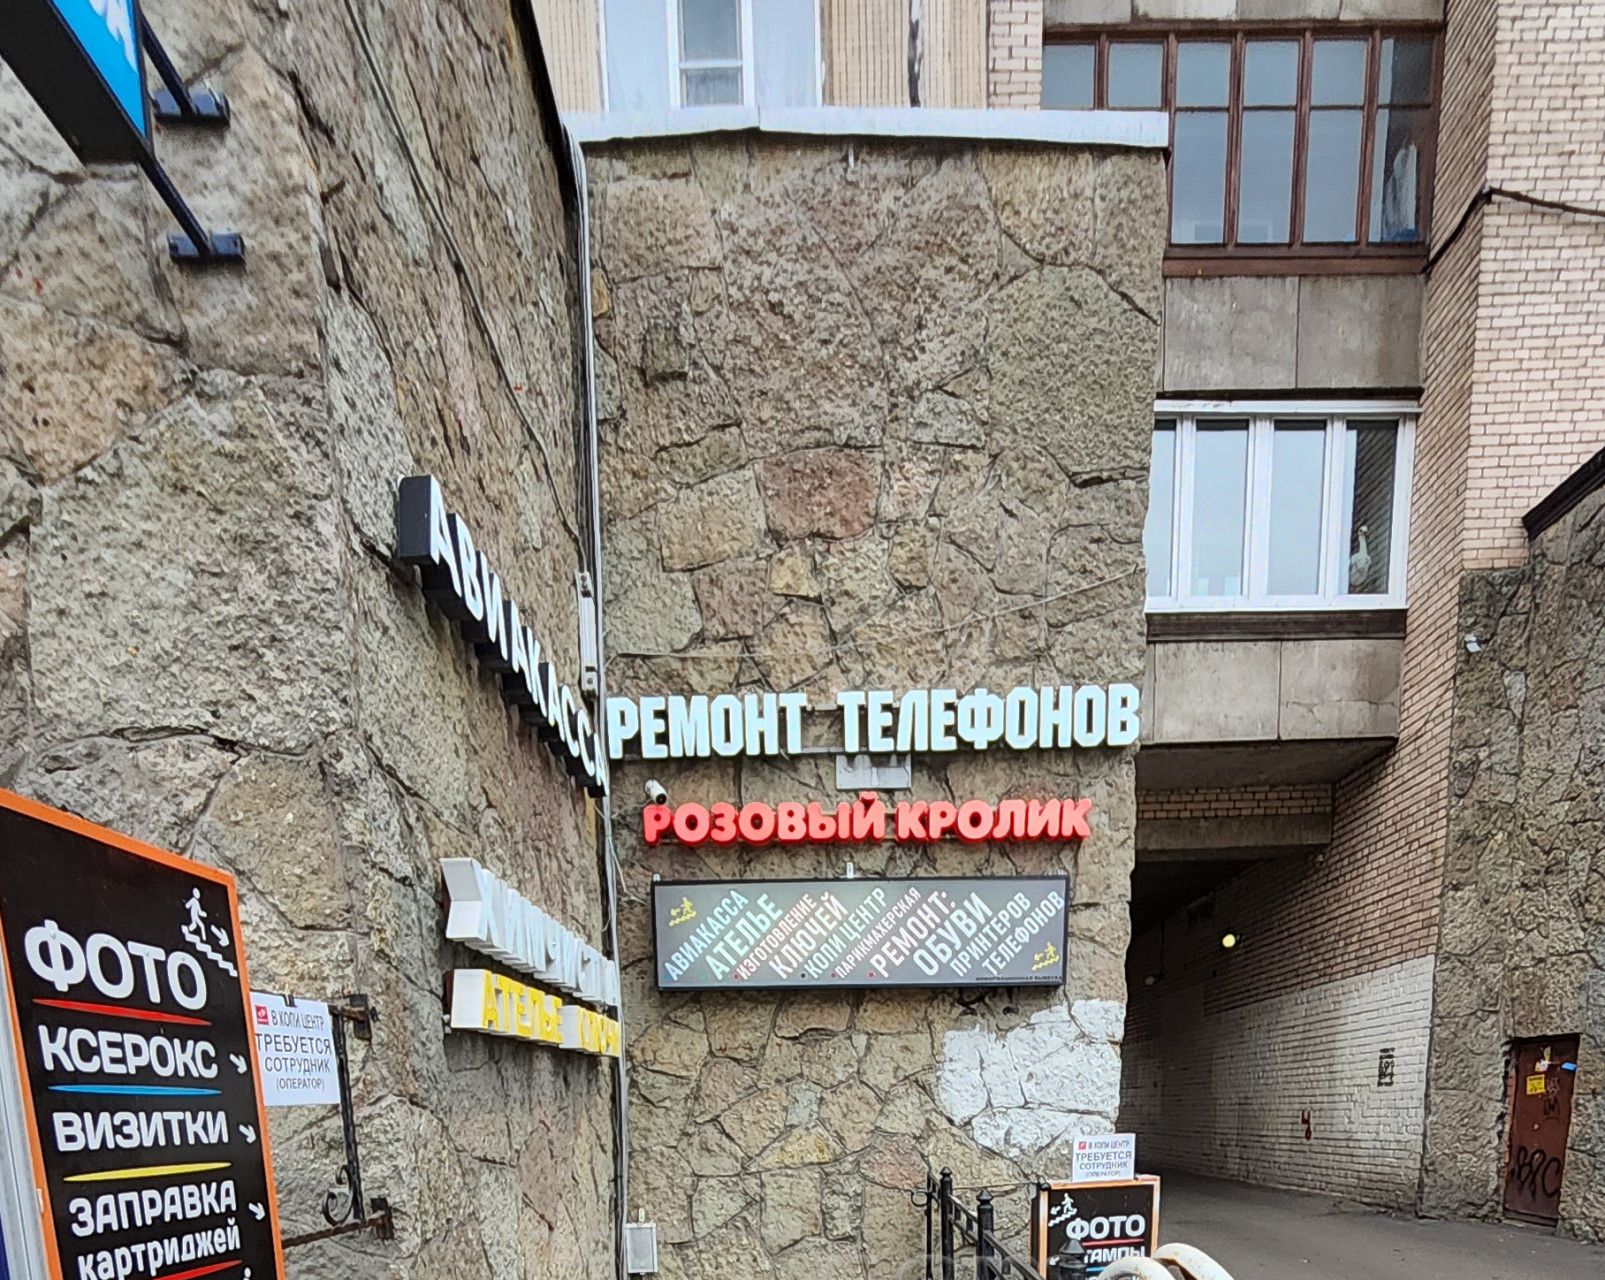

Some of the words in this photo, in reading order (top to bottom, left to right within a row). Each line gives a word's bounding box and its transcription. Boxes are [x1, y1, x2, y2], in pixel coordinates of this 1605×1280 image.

[430, 474, 610, 796] АВИАКАССА
[607, 693, 807, 760] РЕМОНТ
[836, 683, 1140, 753] ТЕЛЕФОНОВ
[643, 791, 886, 845] РОЗОВЫЙ
[895, 798, 1092, 845] КРОЛИК
[24, 919, 207, 1010] ФОТО
[664, 890, 749, 981] АВИАКАССА
[705, 893, 783, 980] АТЕЛЬЕ
[736, 893, 818, 980] ИЗГОТОВЛЕНИЕ
[768, 891, 848, 979] КЛЮЧЕЙ
[803, 933, 847, 979] КОПИ
[839, 887, 887, 942] ЦЕНТР
[834, 886, 922, 979] ПАРИКМАХЕРСКАЯ
[869, 890, 956, 978] РЕМОНТ:
[913, 891, 993, 976] ОБУВИ
[949, 892, 1032, 977] ПРИНТЕРОВ
[982, 890, 1065, 976] ТЕЛЕФОНОВ
[38, 1024, 218, 1079] КСЕРОКС
[255, 1034, 332, 1055] ТРЕБУЕТСЯ
[271, 1010, 278, 1026] В
[280, 1011, 300, 1029] КОПИ
[301, 1014, 325, 1032] ЦЕНТР
[265, 1056, 331, 1076] СОТРУДНИК
[276, 1077, 326, 1092] (ОПЕРАТОР)
[53, 1111, 229, 1152] ВИЗИТКИ
[1075, 1151, 1132, 1162] ТРЕБУЕТСЯ
[1080, 1161, 1128, 1171] СОТРУДНИК
[69, 1180, 237, 1237] ЗАПРАВКА
[1066, 1214, 1146, 1241] ФОТО
[1083, 1246, 1146, 1264] ТАМПЫ
